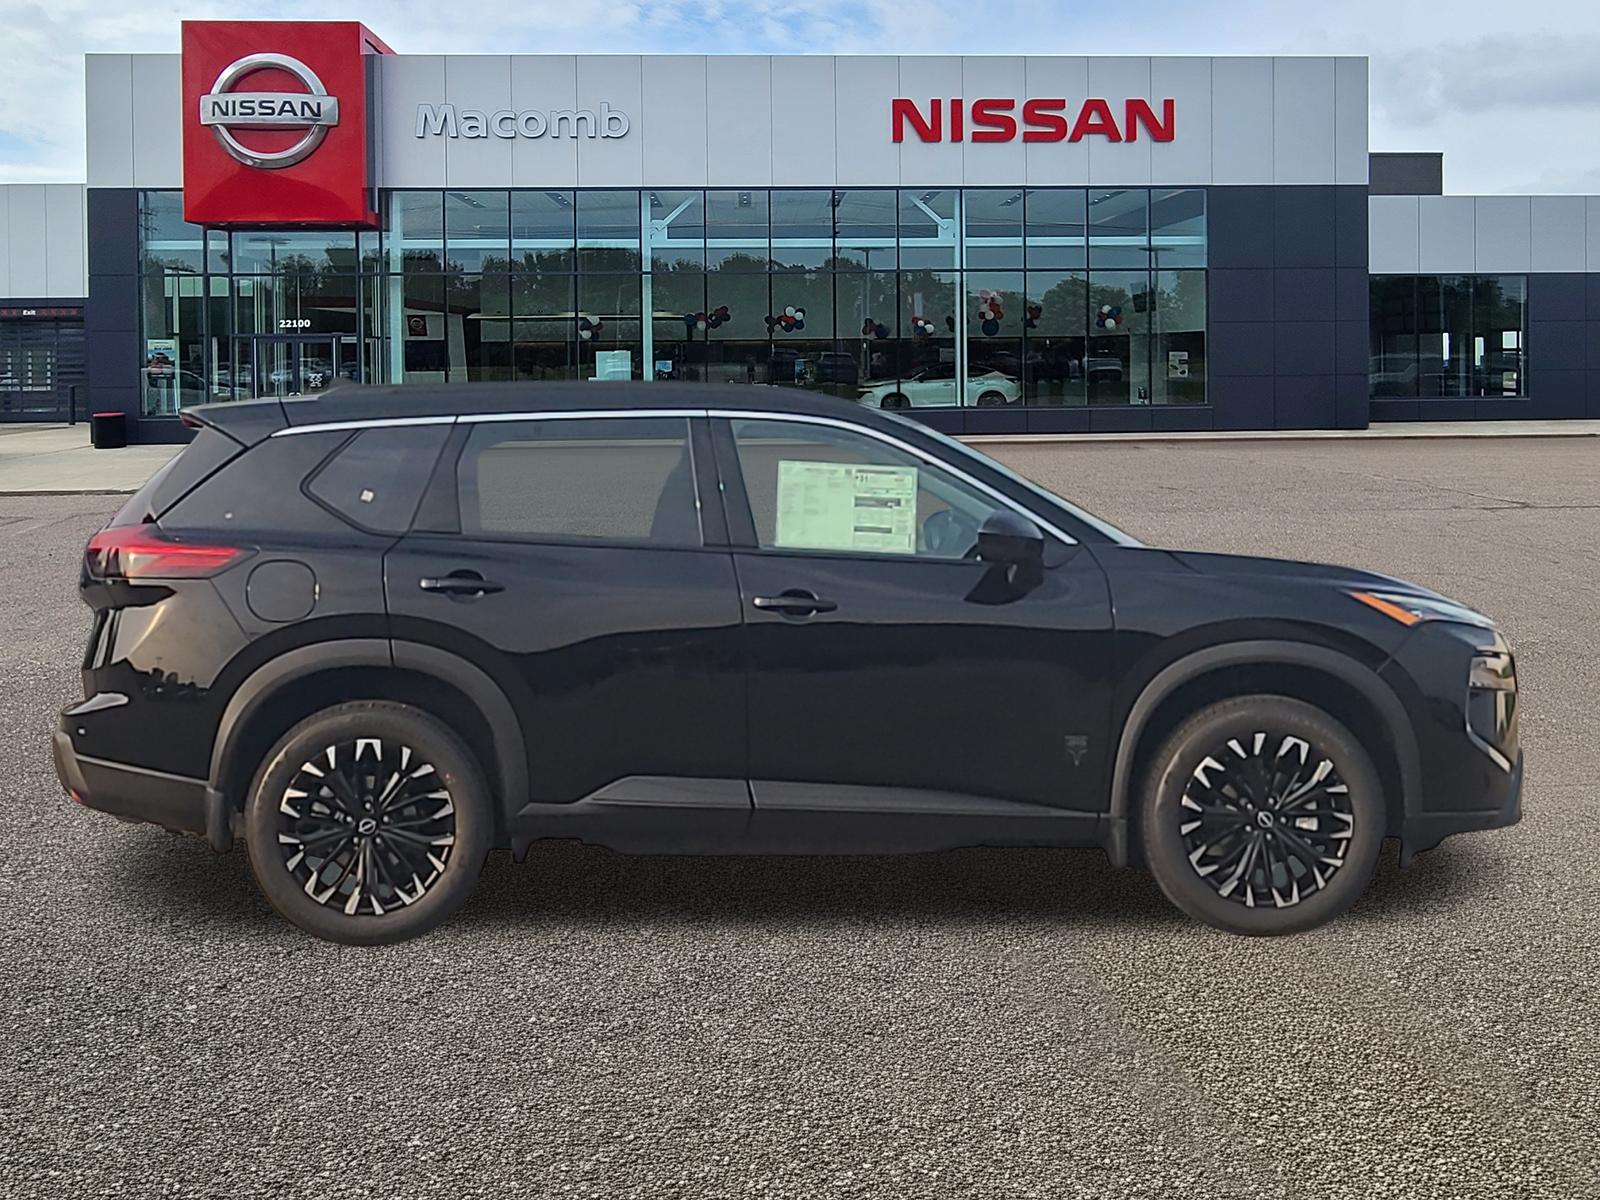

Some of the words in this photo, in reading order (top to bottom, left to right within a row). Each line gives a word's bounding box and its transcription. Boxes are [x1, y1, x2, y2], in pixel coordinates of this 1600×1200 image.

[211, 100, 322, 118] NISSAN
[415, 102, 630, 139] Macomb
[892, 98, 1175, 143] NISSAN
[279, 319, 311, 328] 22100
